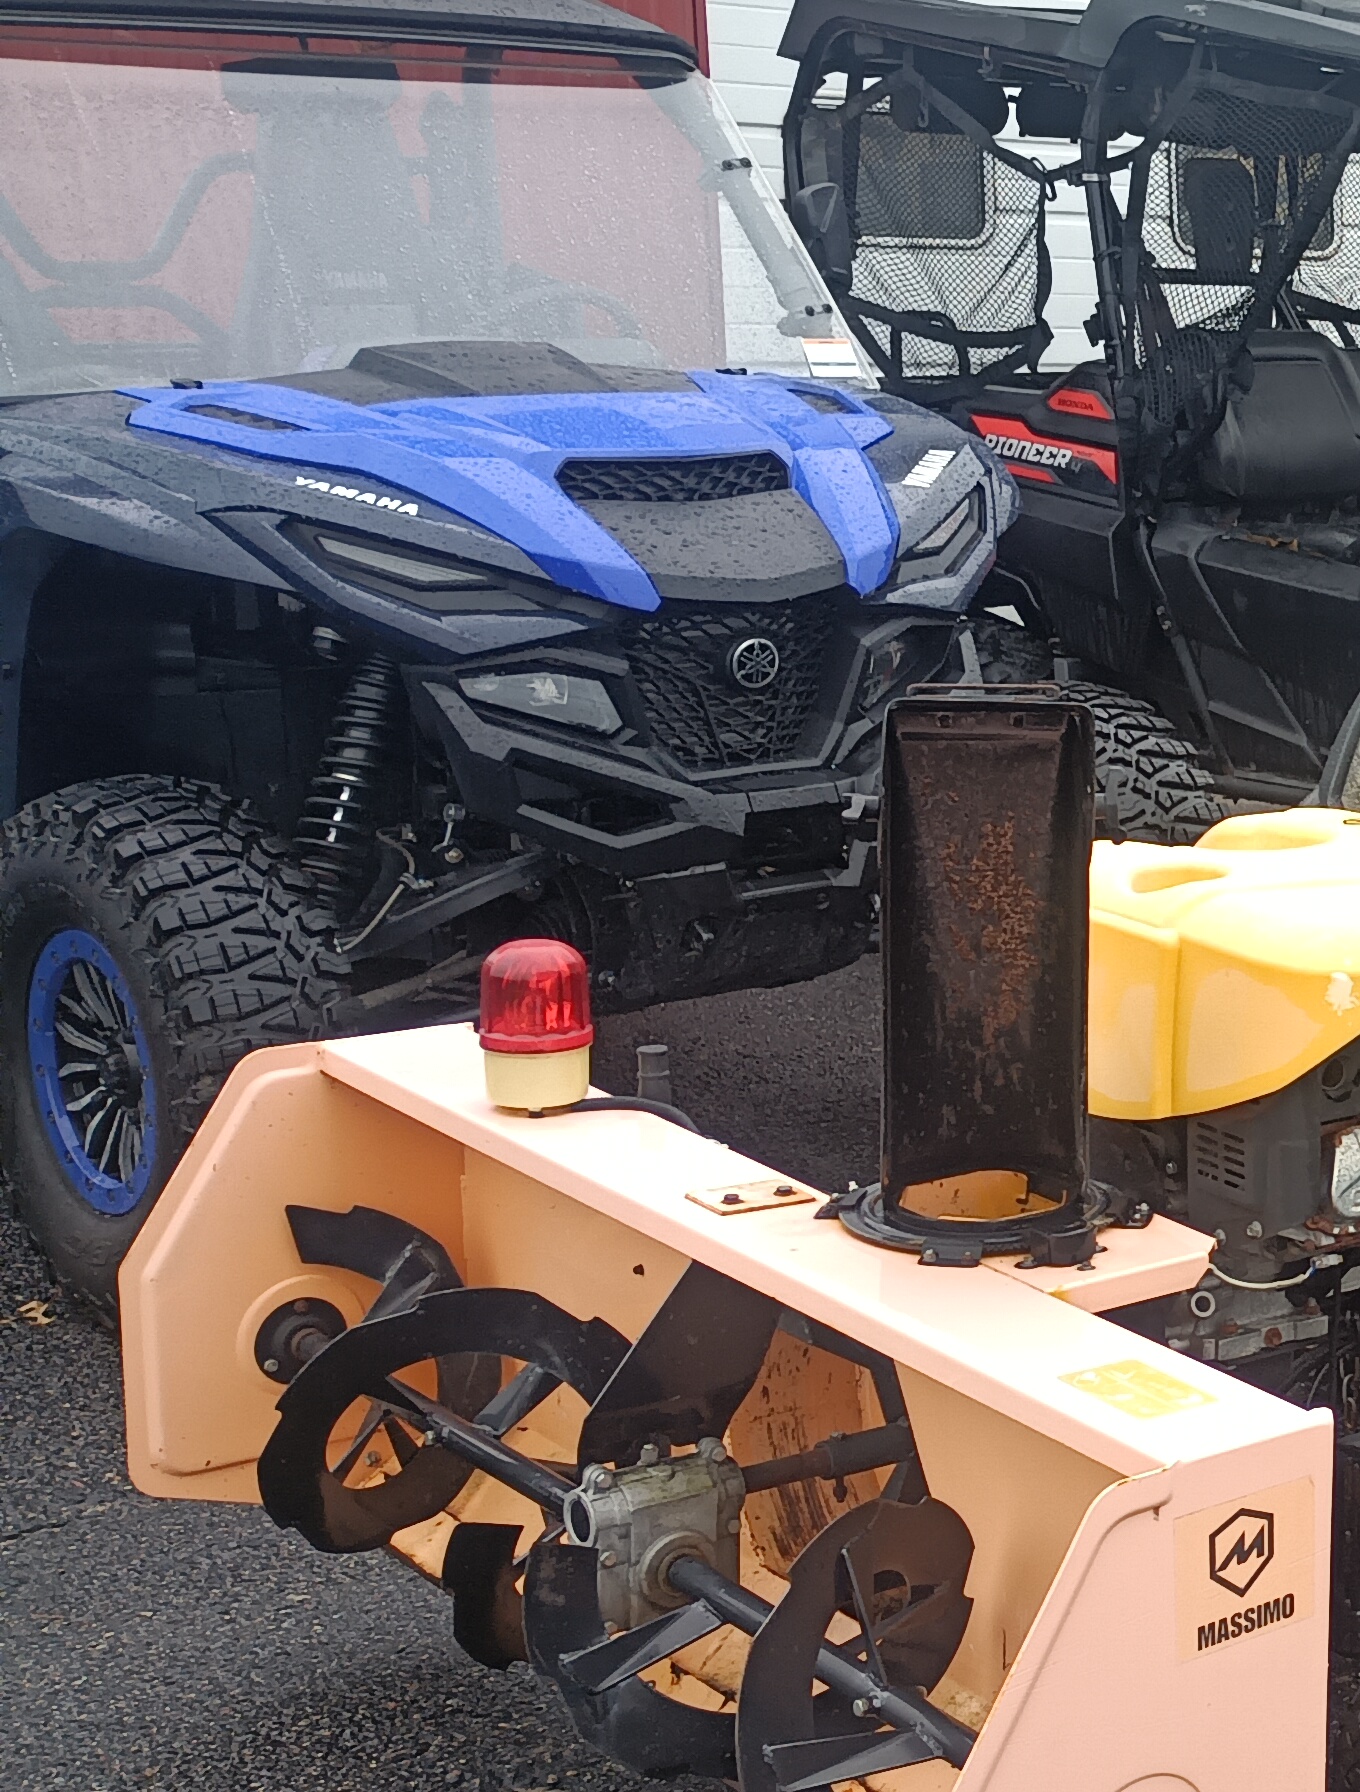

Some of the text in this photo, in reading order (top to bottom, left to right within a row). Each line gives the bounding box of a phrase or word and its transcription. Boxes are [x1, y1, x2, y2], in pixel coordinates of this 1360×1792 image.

[1057, 397, 1094, 411] HONDA
[984, 433, 1073, 469] PIONEER
[294, 475, 419, 516] YAMAHA
[1197, 1593, 1295, 1651] MASSIMO
